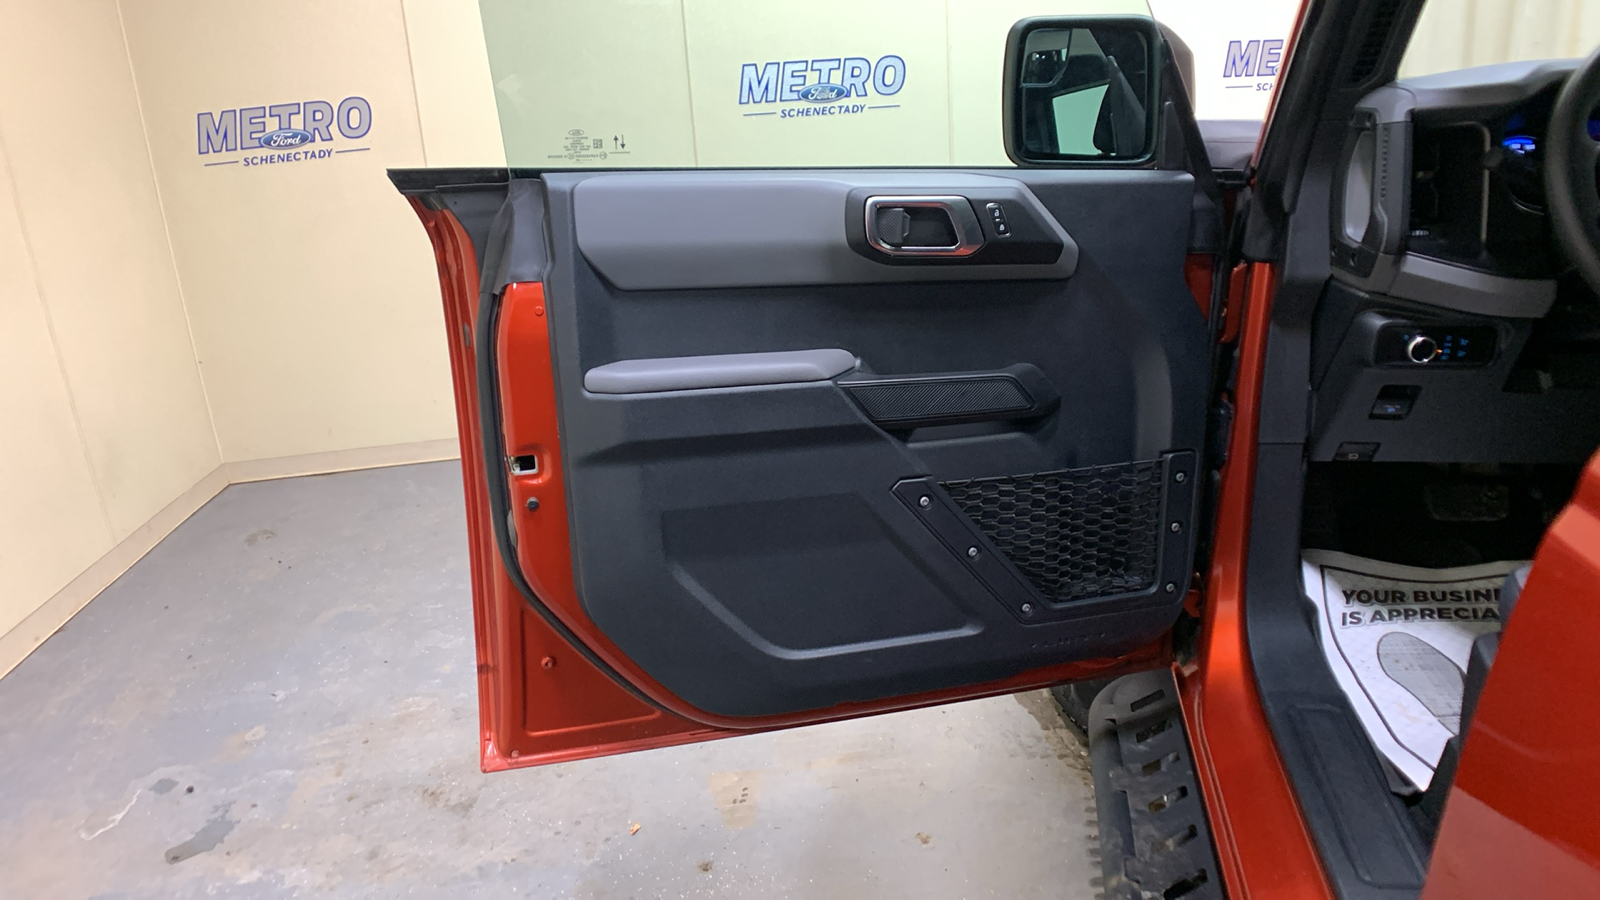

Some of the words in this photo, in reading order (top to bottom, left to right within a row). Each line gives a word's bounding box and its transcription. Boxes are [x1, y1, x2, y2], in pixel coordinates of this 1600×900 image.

[738, 54, 906, 104] METRO
[780, 104, 866, 118] SCHENECTADY
[197, 96, 372, 155] METRO
[270, 132, 302, 147] Ford
[243, 148, 334, 167] SCHENECTADY
[1342, 589, 1406, 605] YOUR
[1341, 611, 1362, 627] IS
